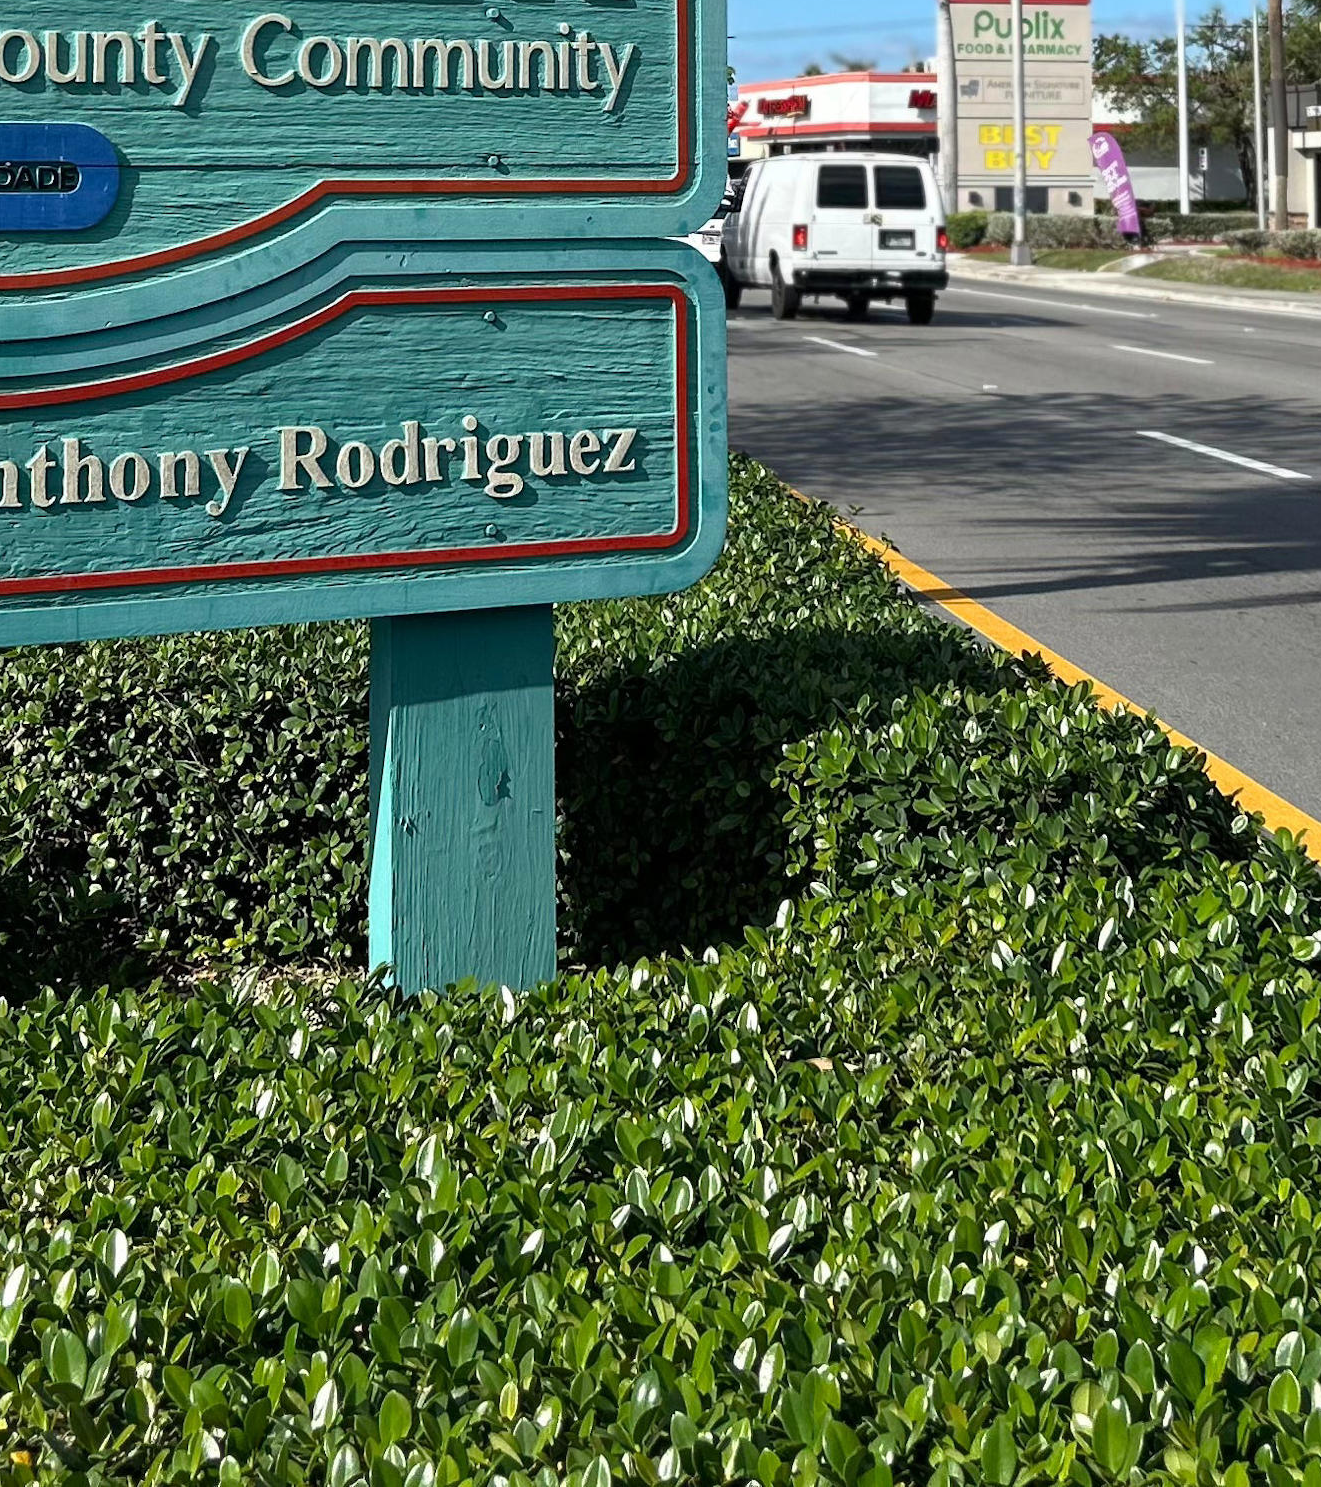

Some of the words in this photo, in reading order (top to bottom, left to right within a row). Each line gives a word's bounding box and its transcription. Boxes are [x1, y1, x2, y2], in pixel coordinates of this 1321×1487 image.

[241, 13, 635, 112] Community
[957, 43, 994, 55] FOOD
[1010, 44, 1082, 56] ARMACY
[278, 415, 638, 499] Rodriguez
